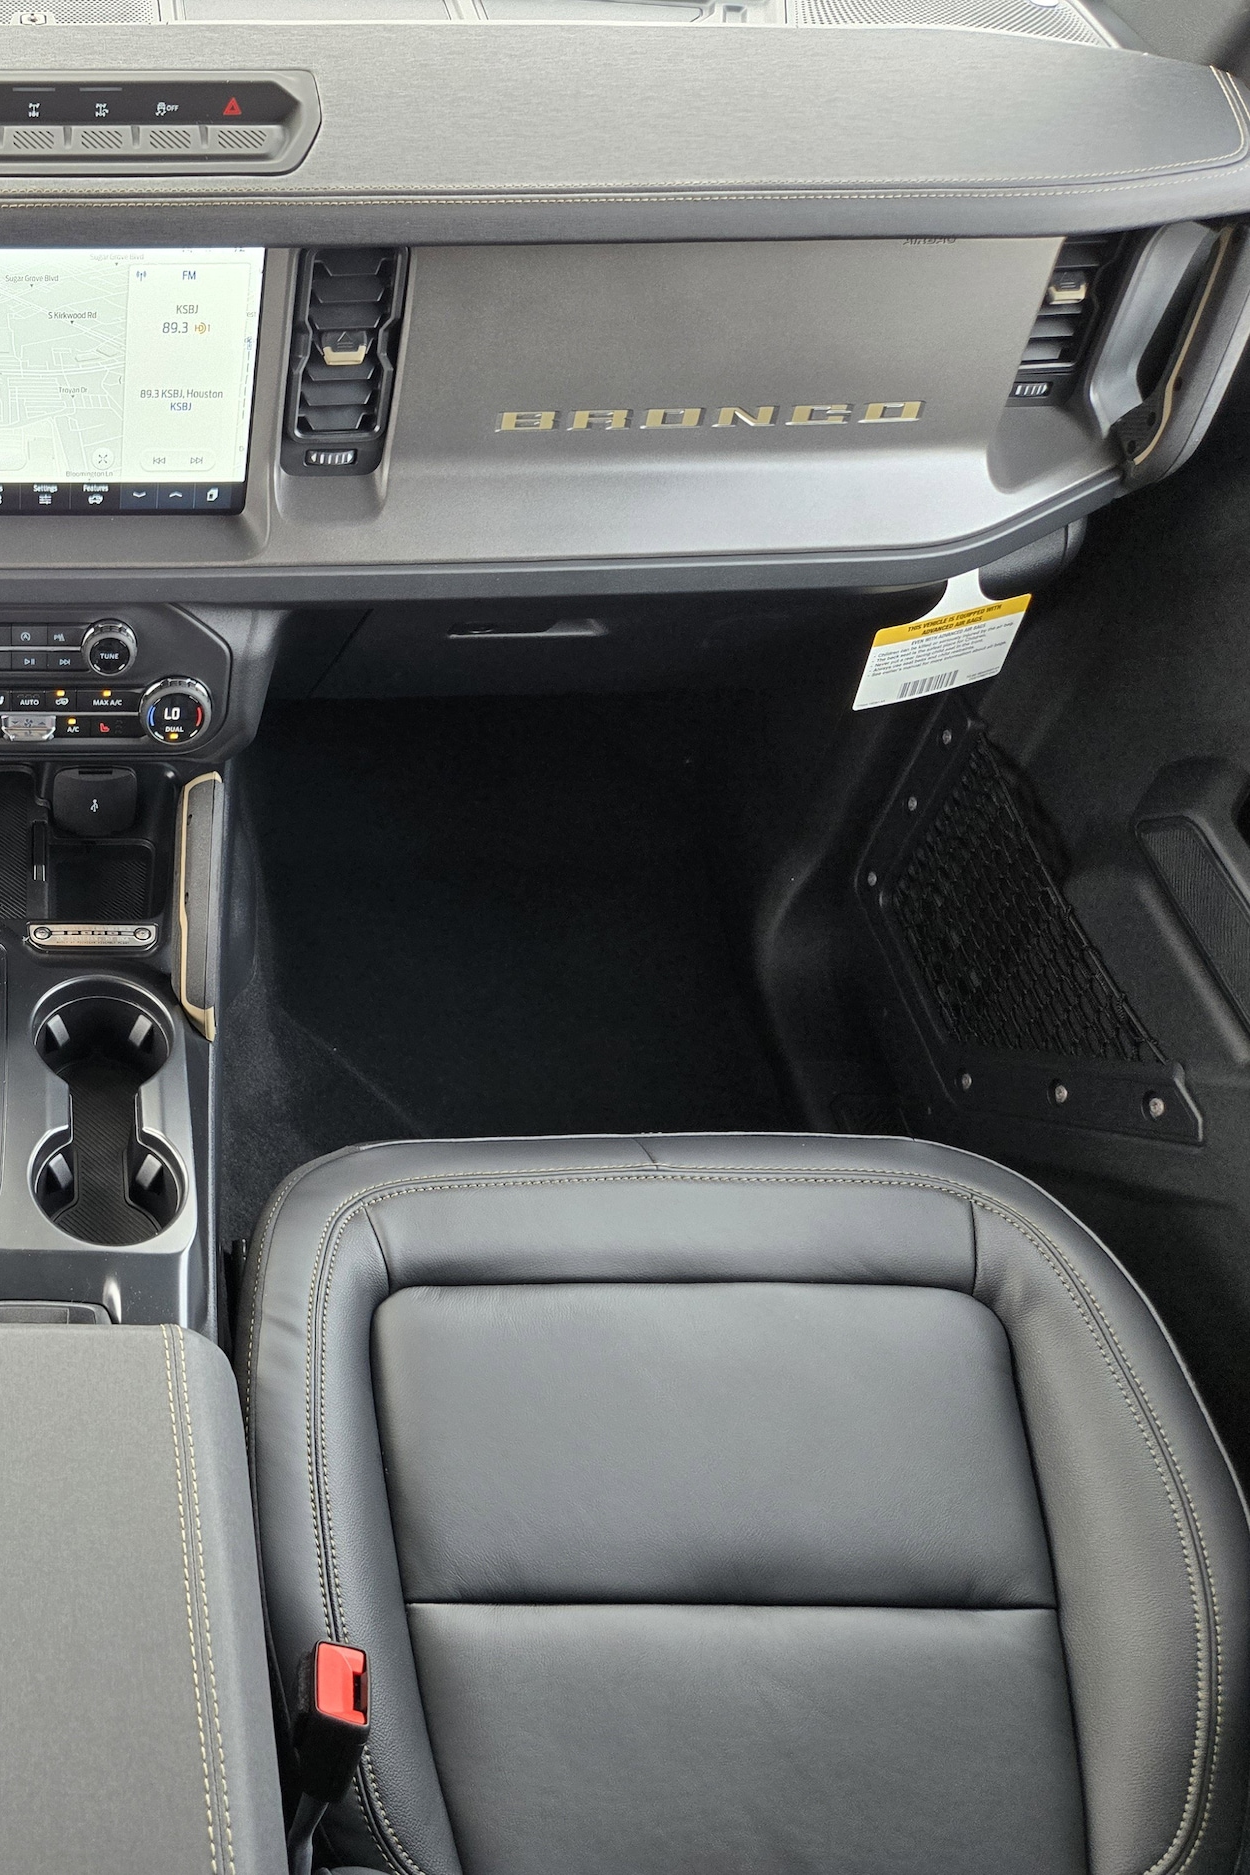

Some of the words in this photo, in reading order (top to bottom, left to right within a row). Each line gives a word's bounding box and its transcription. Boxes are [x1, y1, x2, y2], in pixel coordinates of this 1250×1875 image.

[5, 275, 24, 283] Sugar
[44, 274, 59, 282] Blvd
[182, 270, 197, 280] FM
[176, 304, 199, 315] KSBJ
[87, 311, 97, 319] Rd
[162, 322, 189, 334] 89.3
[139, 389, 160, 399] 89.3
[161, 389, 185, 400] KSBJ,
[186, 389, 223, 399] Houston
[170, 402, 192, 412] KSBJ
[494, 401, 925, 433] BRONCO
[33, 484, 58, 494] Settings
[82, 484, 109, 493] Features
[923, 618, 947, 628] VEHICLE
[956, 609, 985, 619] EQUIPPED
[921, 623, 953, 634] ADVANCED
[938, 629, 963, 638] ADVANCED
[163, 707, 181, 721] LO
